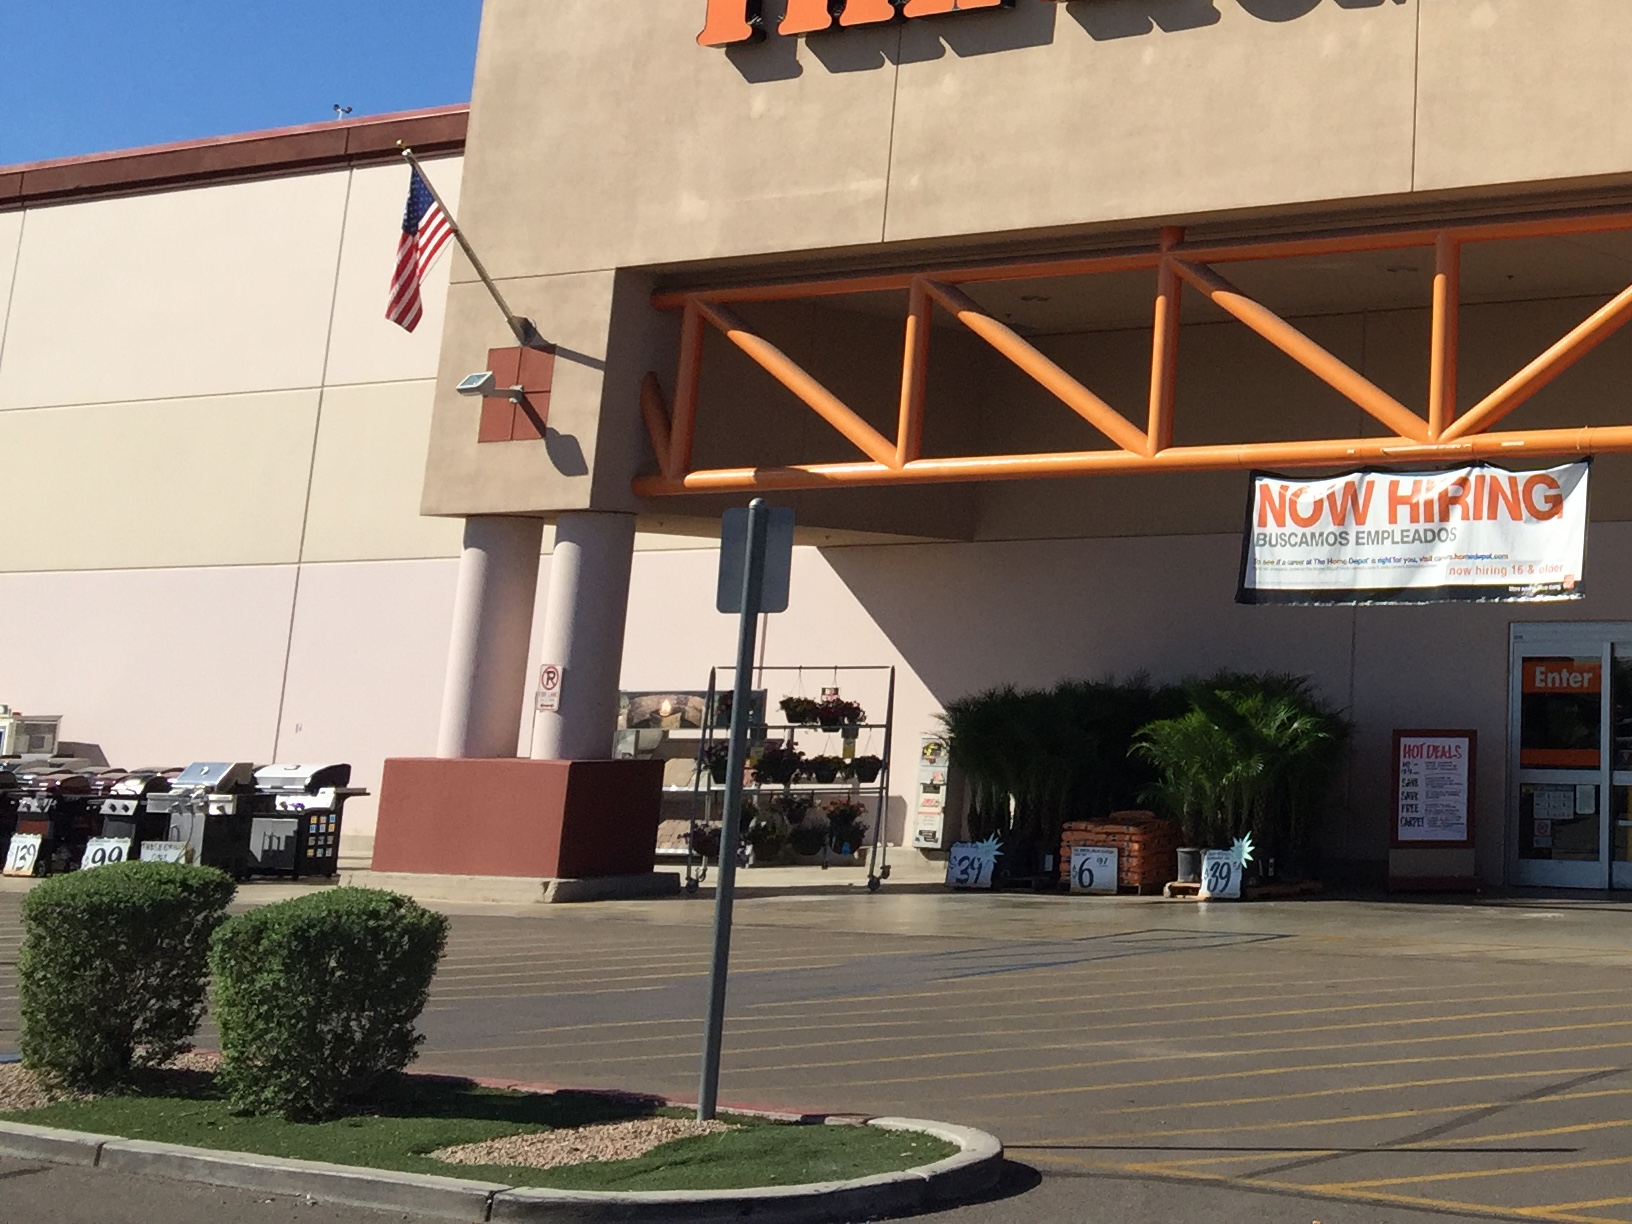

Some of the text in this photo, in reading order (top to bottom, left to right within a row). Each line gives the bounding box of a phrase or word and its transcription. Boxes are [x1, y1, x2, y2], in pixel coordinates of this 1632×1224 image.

[1257, 473, 1564, 528] NOW HIRING
[1254, 526, 1457, 548] BUSCAMOS EMPLEADOS
[1449, 566, 1471, 575] now
[1475, 564, 1507, 577] hiring
[1511, 565, 1524, 575] 16
[1538, 564, 1564, 574] older
[1534, 665, 1593, 688] Enter
[1403, 743, 1463, 759] HOT DEALS
